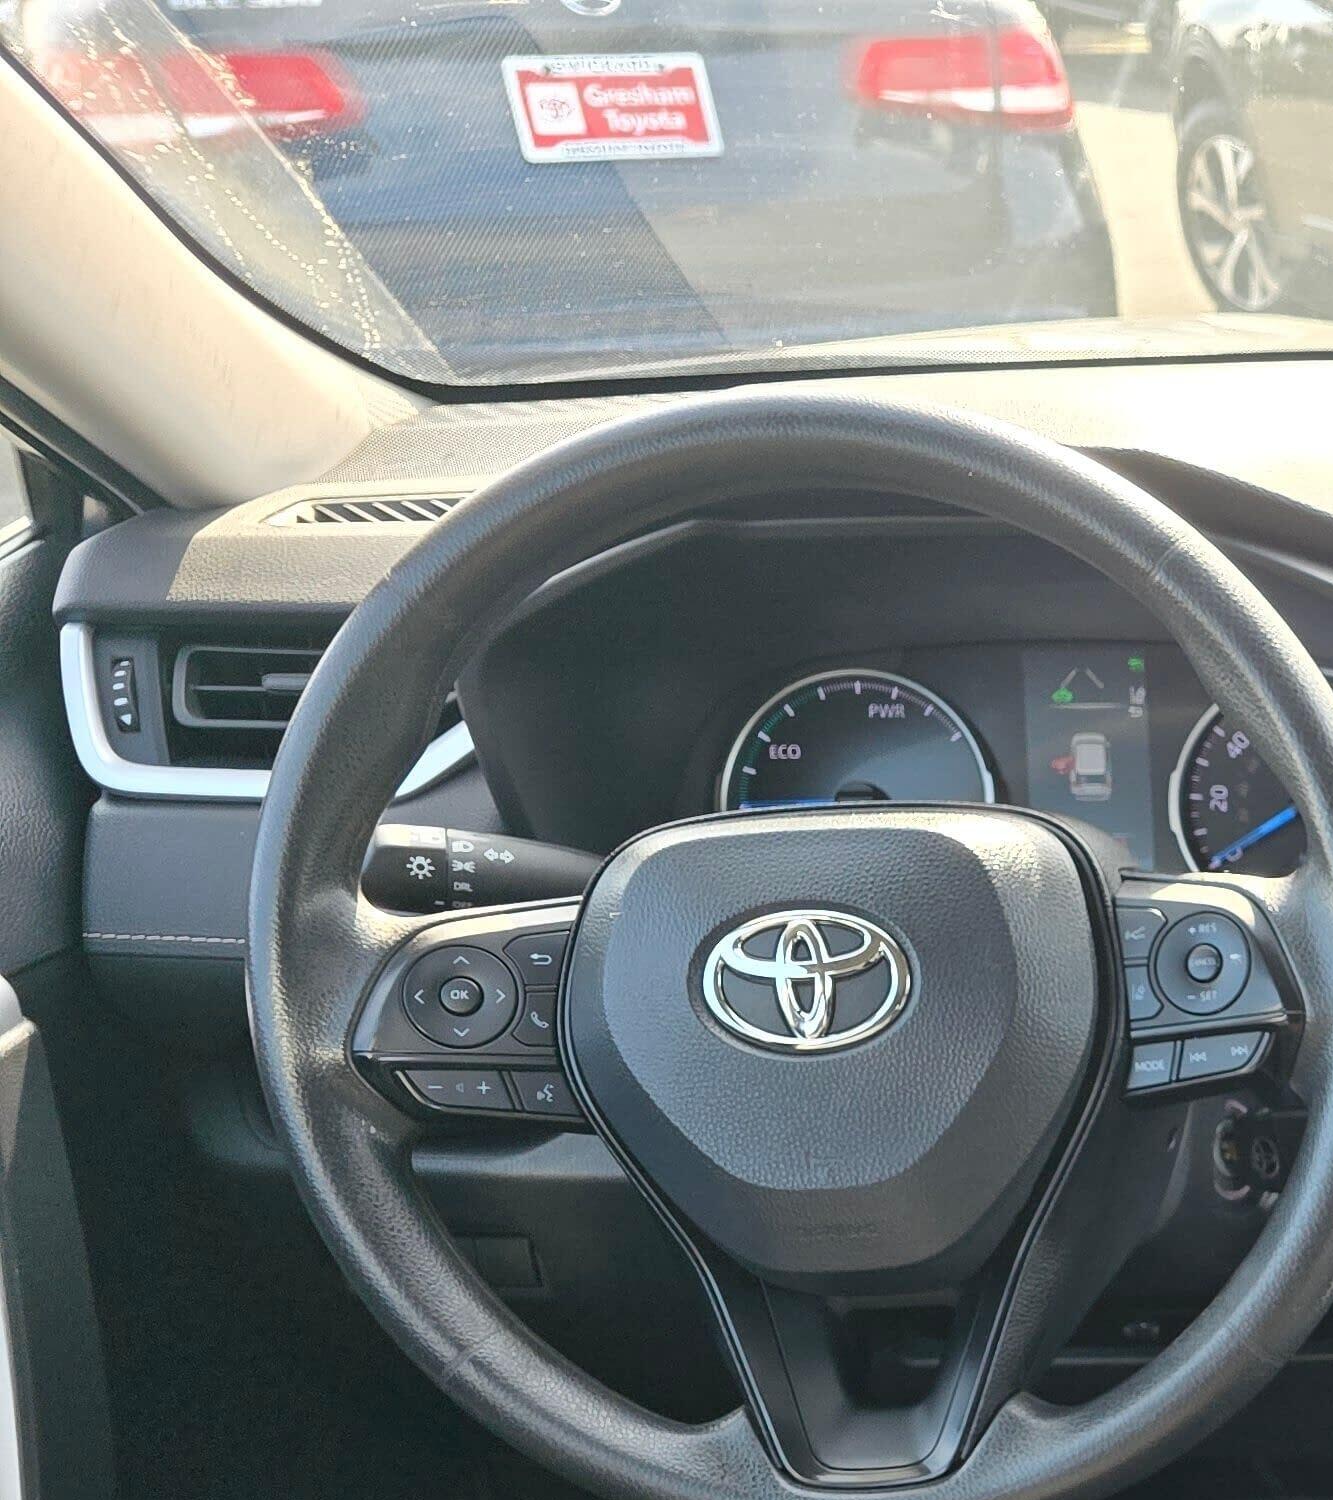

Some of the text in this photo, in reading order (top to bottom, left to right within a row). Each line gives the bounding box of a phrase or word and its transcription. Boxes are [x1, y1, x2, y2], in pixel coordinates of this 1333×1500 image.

[584, 83, 694, 107] Gresham
[604, 108, 687, 136] Toyota
[868, 703, 905, 718] PWR
[768, 744, 801, 760] ECO
[1226, 730, 1250, 760] 40
[1209, 784, 1229, 813] 20
[450, 989, 470, 1000] OK
[1134, 1060, 1166, 1073] MODE
